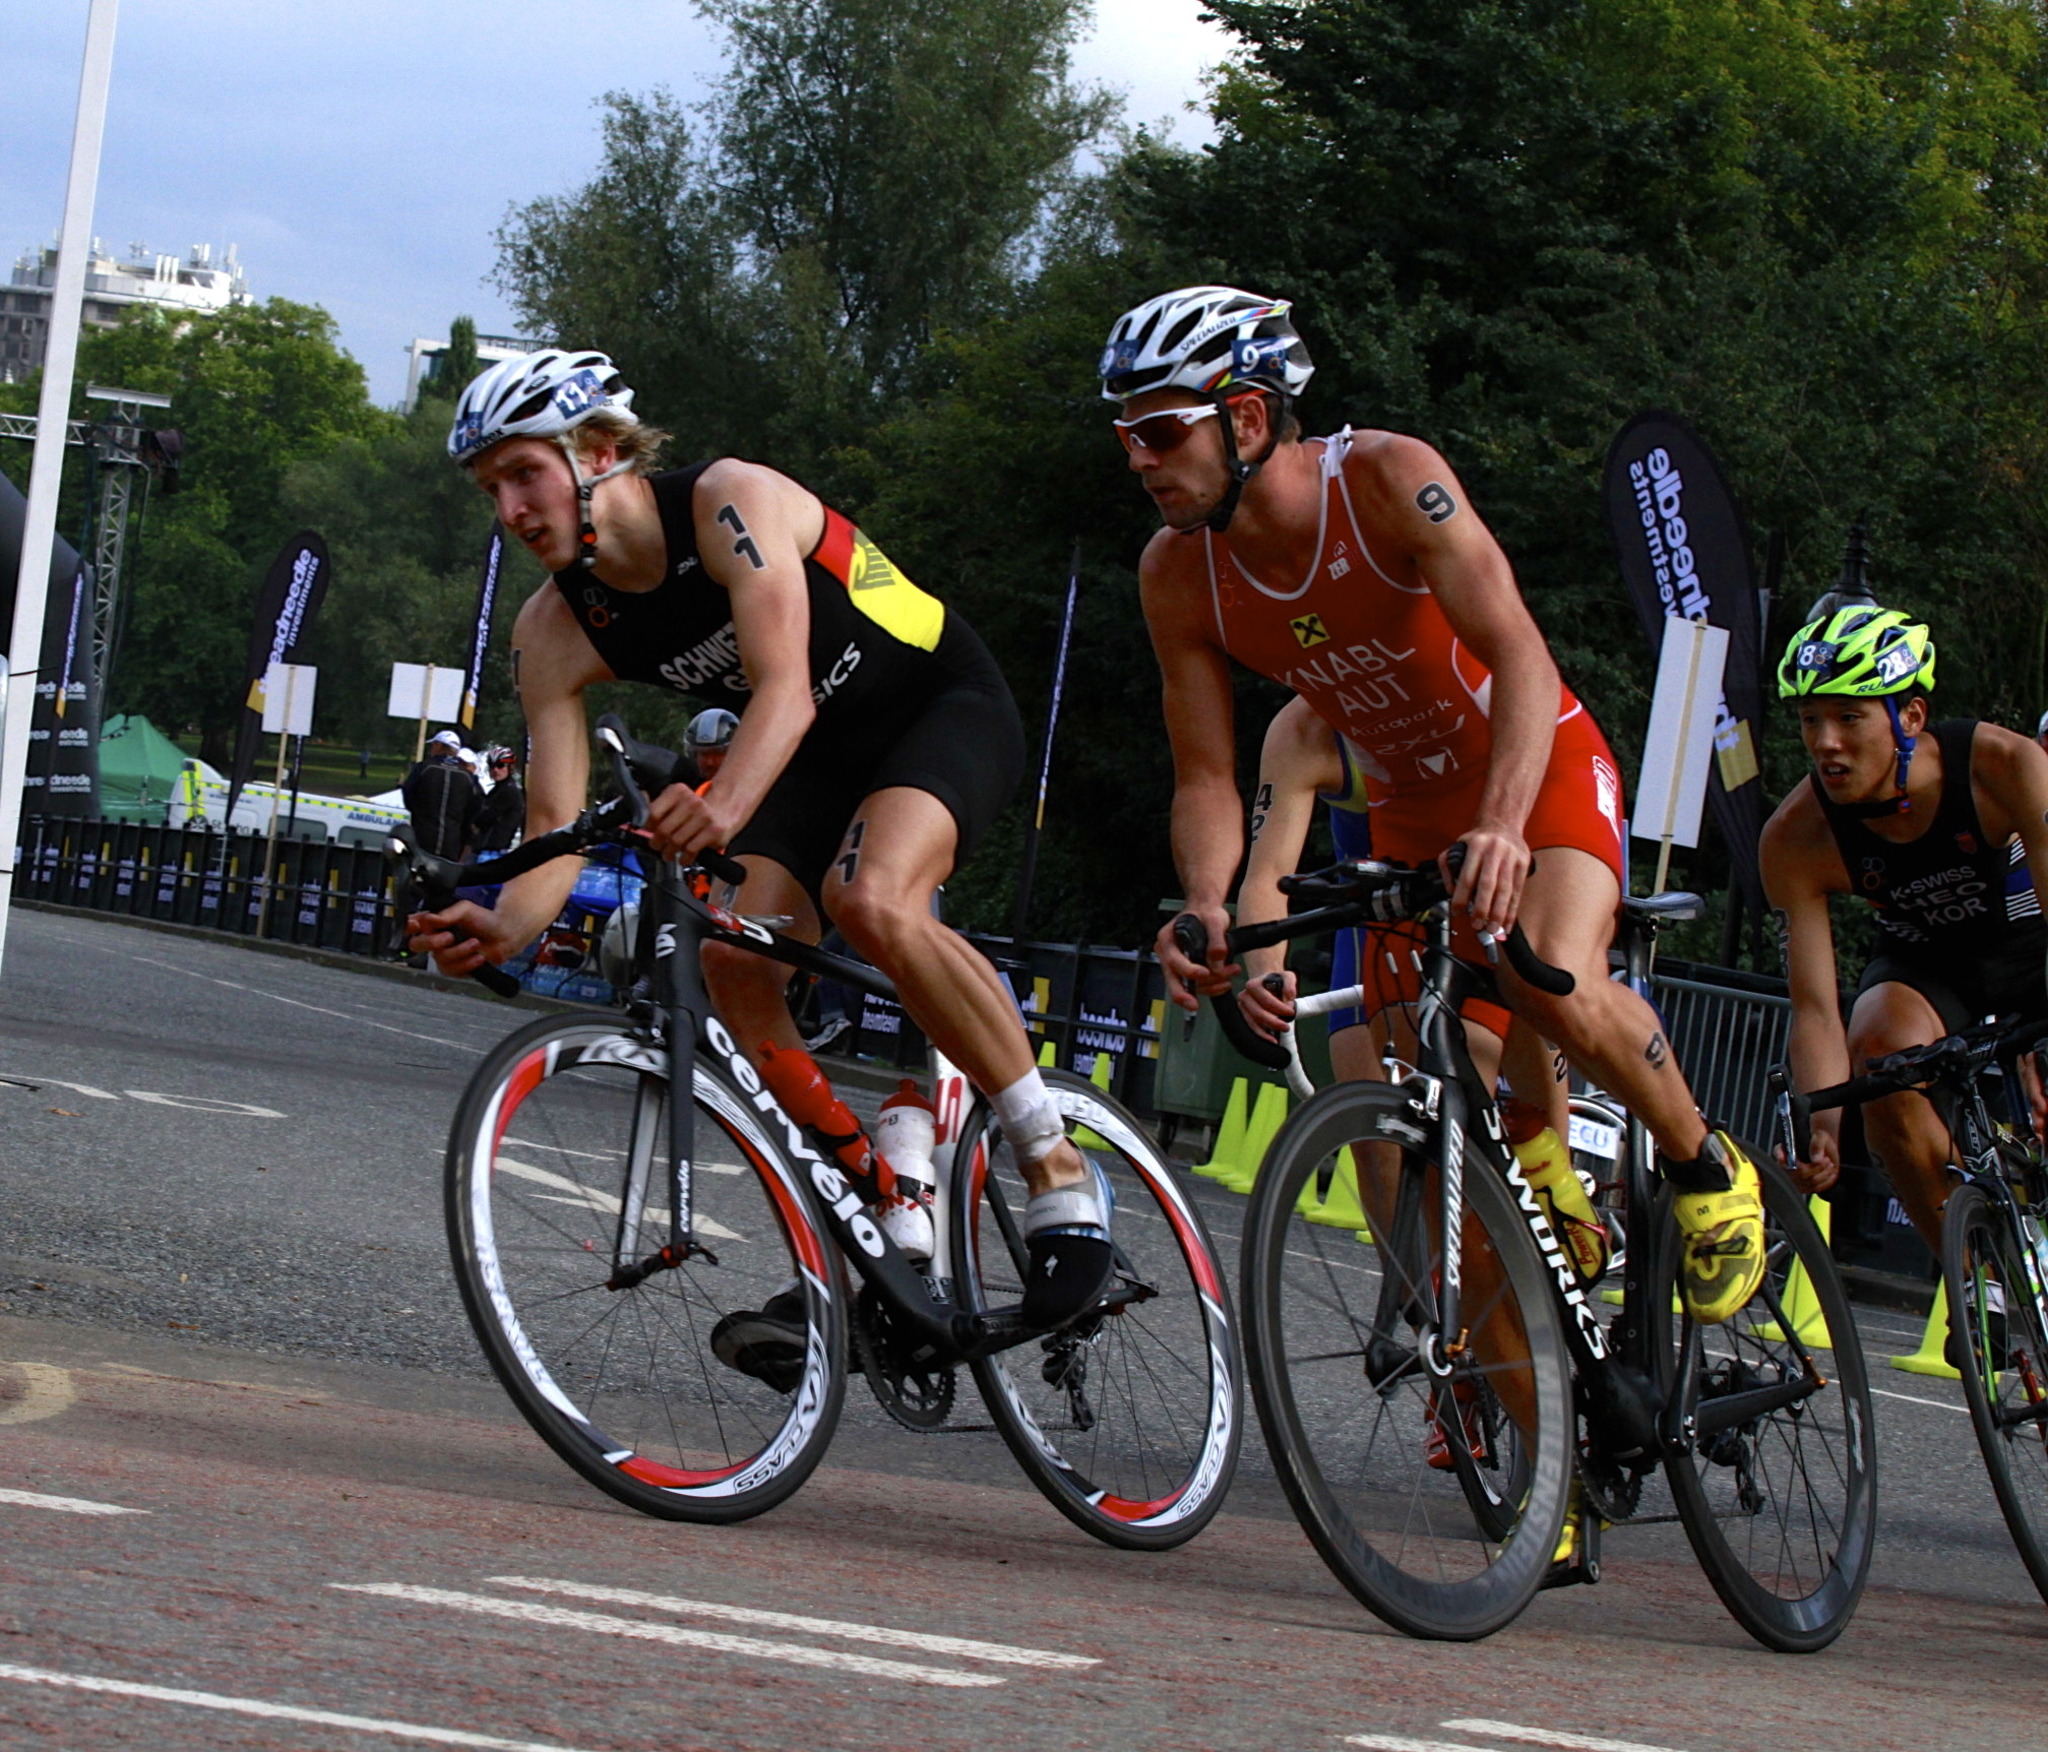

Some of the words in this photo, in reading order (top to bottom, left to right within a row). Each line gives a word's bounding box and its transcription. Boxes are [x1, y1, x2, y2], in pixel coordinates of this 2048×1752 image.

[1241, 344, 1260, 373] 9
[555, 382, 588, 412] 11
[1415, 483, 1456, 524] 9
[659, 620, 739, 691] SCHWE
[811, 642, 862, 705] SICS
[1273, 638, 1416, 693] KNABL
[1799, 645, 1817, 666] 8
[1877, 651, 1908, 685] 28
[1335, 673, 1410, 717] AUT
[1922, 897, 1989, 927] KOR
[1552, 1052, 1567, 1083] 2
[1447, 1117, 1465, 1292] SPECIALIZED
[1483, 1105, 1612, 1361] S-WORKS
